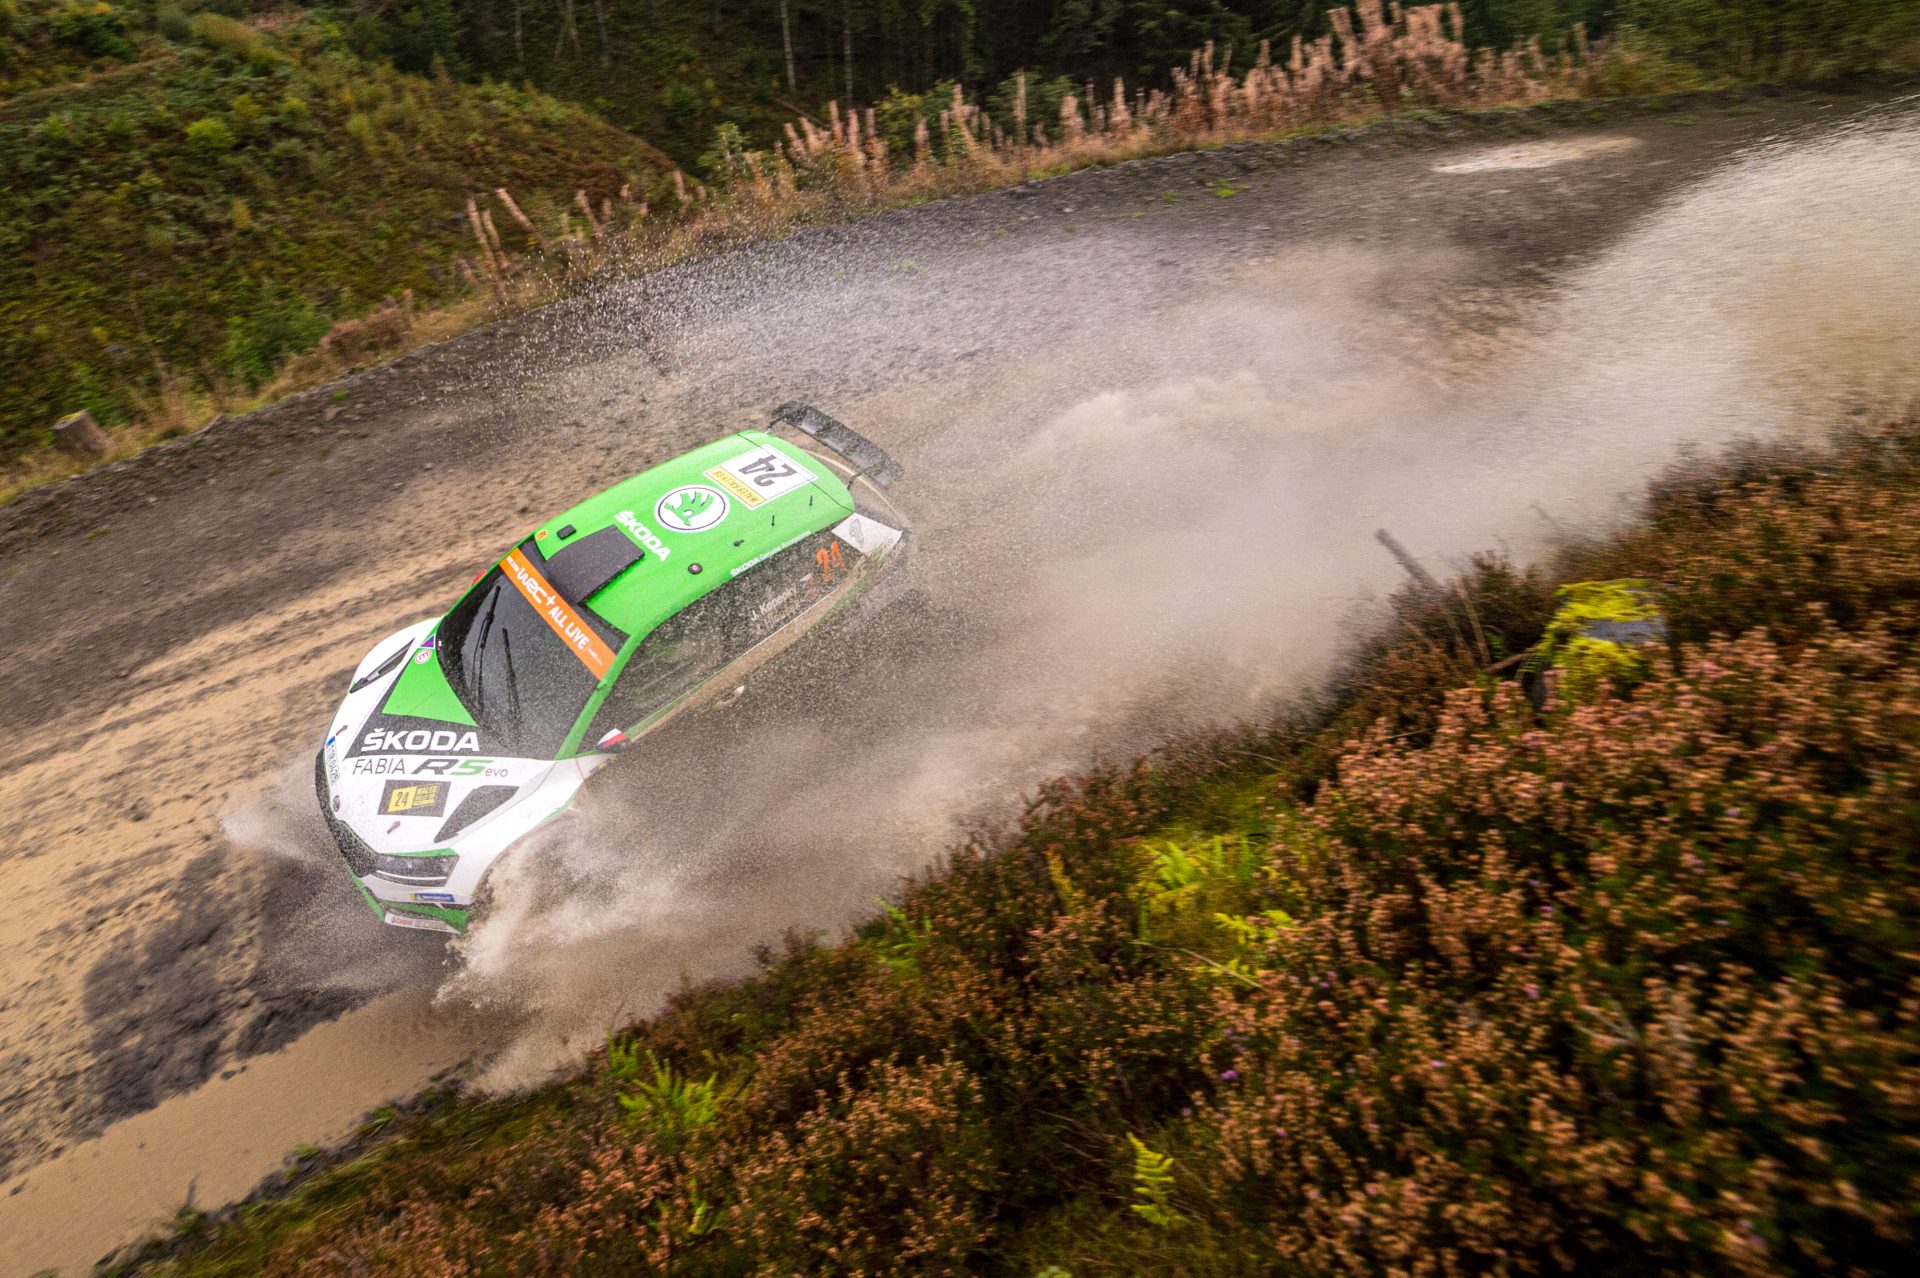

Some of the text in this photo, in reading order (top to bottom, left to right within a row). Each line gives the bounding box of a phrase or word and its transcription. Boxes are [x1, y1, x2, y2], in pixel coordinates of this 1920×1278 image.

[738, 455, 798, 487] 24
[614, 510, 671, 561] ŠKODA
[548, 606, 569, 628] ALL
[565, 622, 590, 650] LIVE
[361, 728, 480, 752] ŠKODA
[352, 758, 508, 778] FABIA R5 evo
[394, 791, 410, 807] 24
